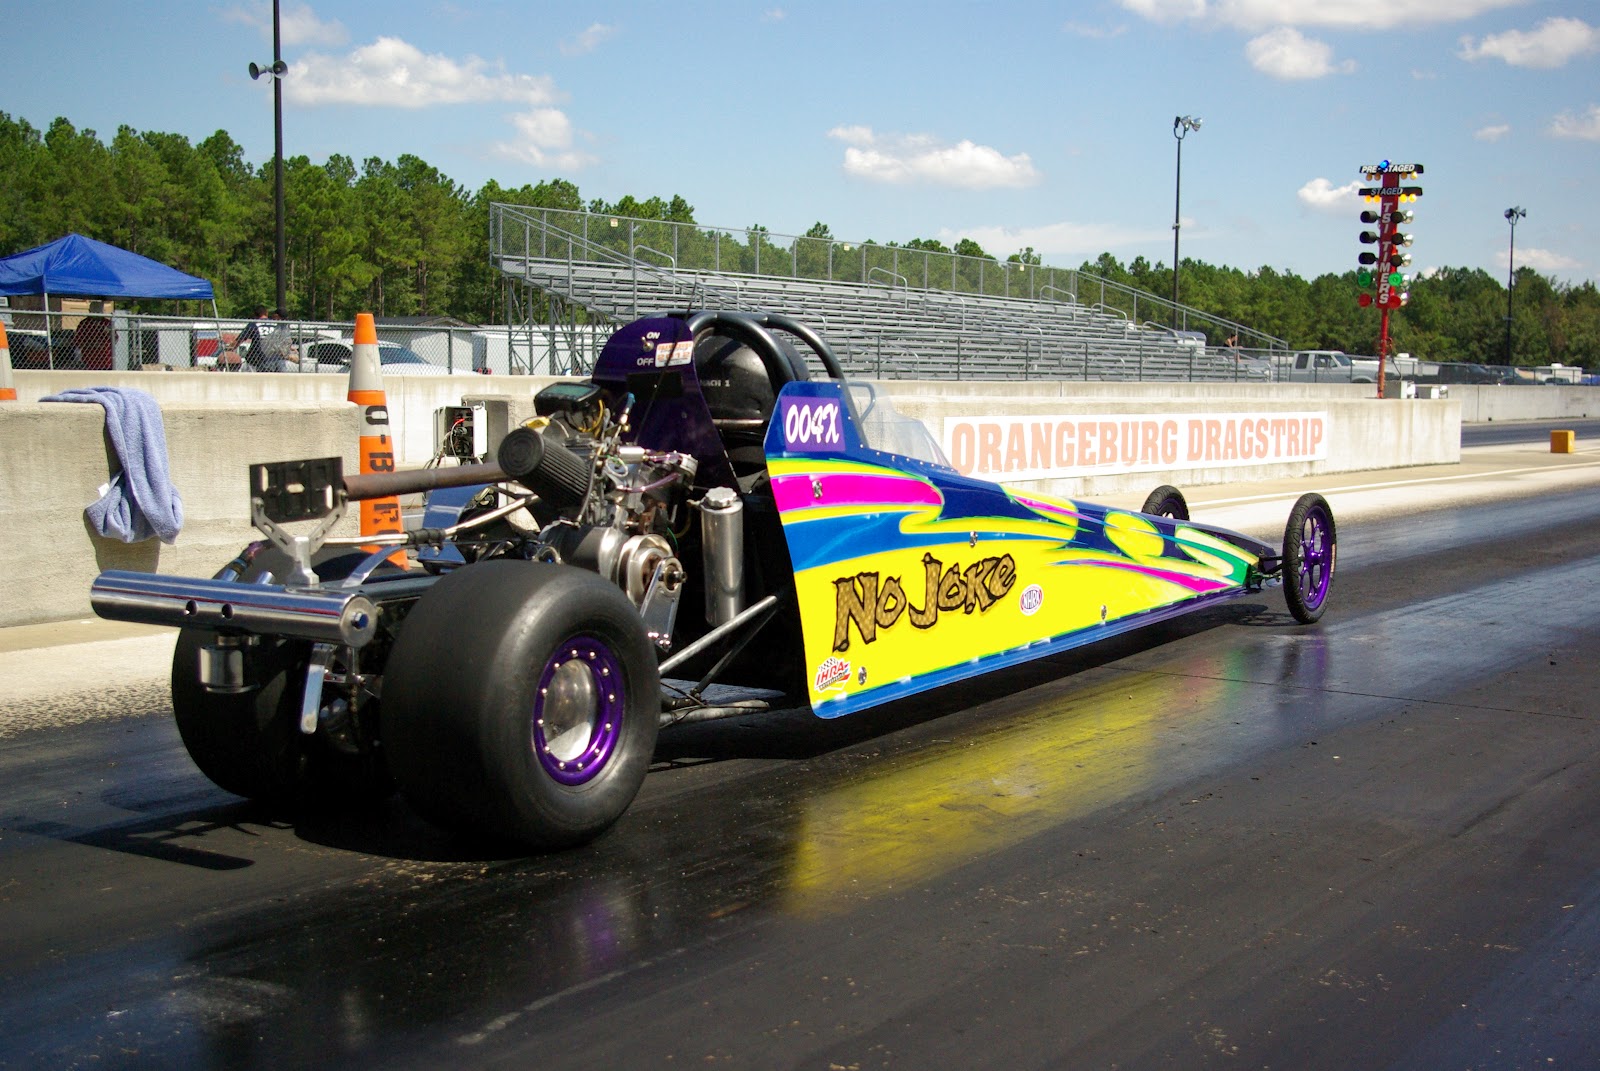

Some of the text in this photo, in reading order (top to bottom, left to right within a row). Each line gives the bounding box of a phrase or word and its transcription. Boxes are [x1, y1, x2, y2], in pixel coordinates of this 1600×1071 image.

[1370, 187, 1404, 196] STAGED
[1379, 202, 1393, 304] TSI TIMERS
[646, 331, 661, 340] ON
[636, 357, 655, 367] OFF
[951, 417, 1324, 475] ORANGEBURG DRAGSTRIP
[816, 661, 845, 686] IHRA
